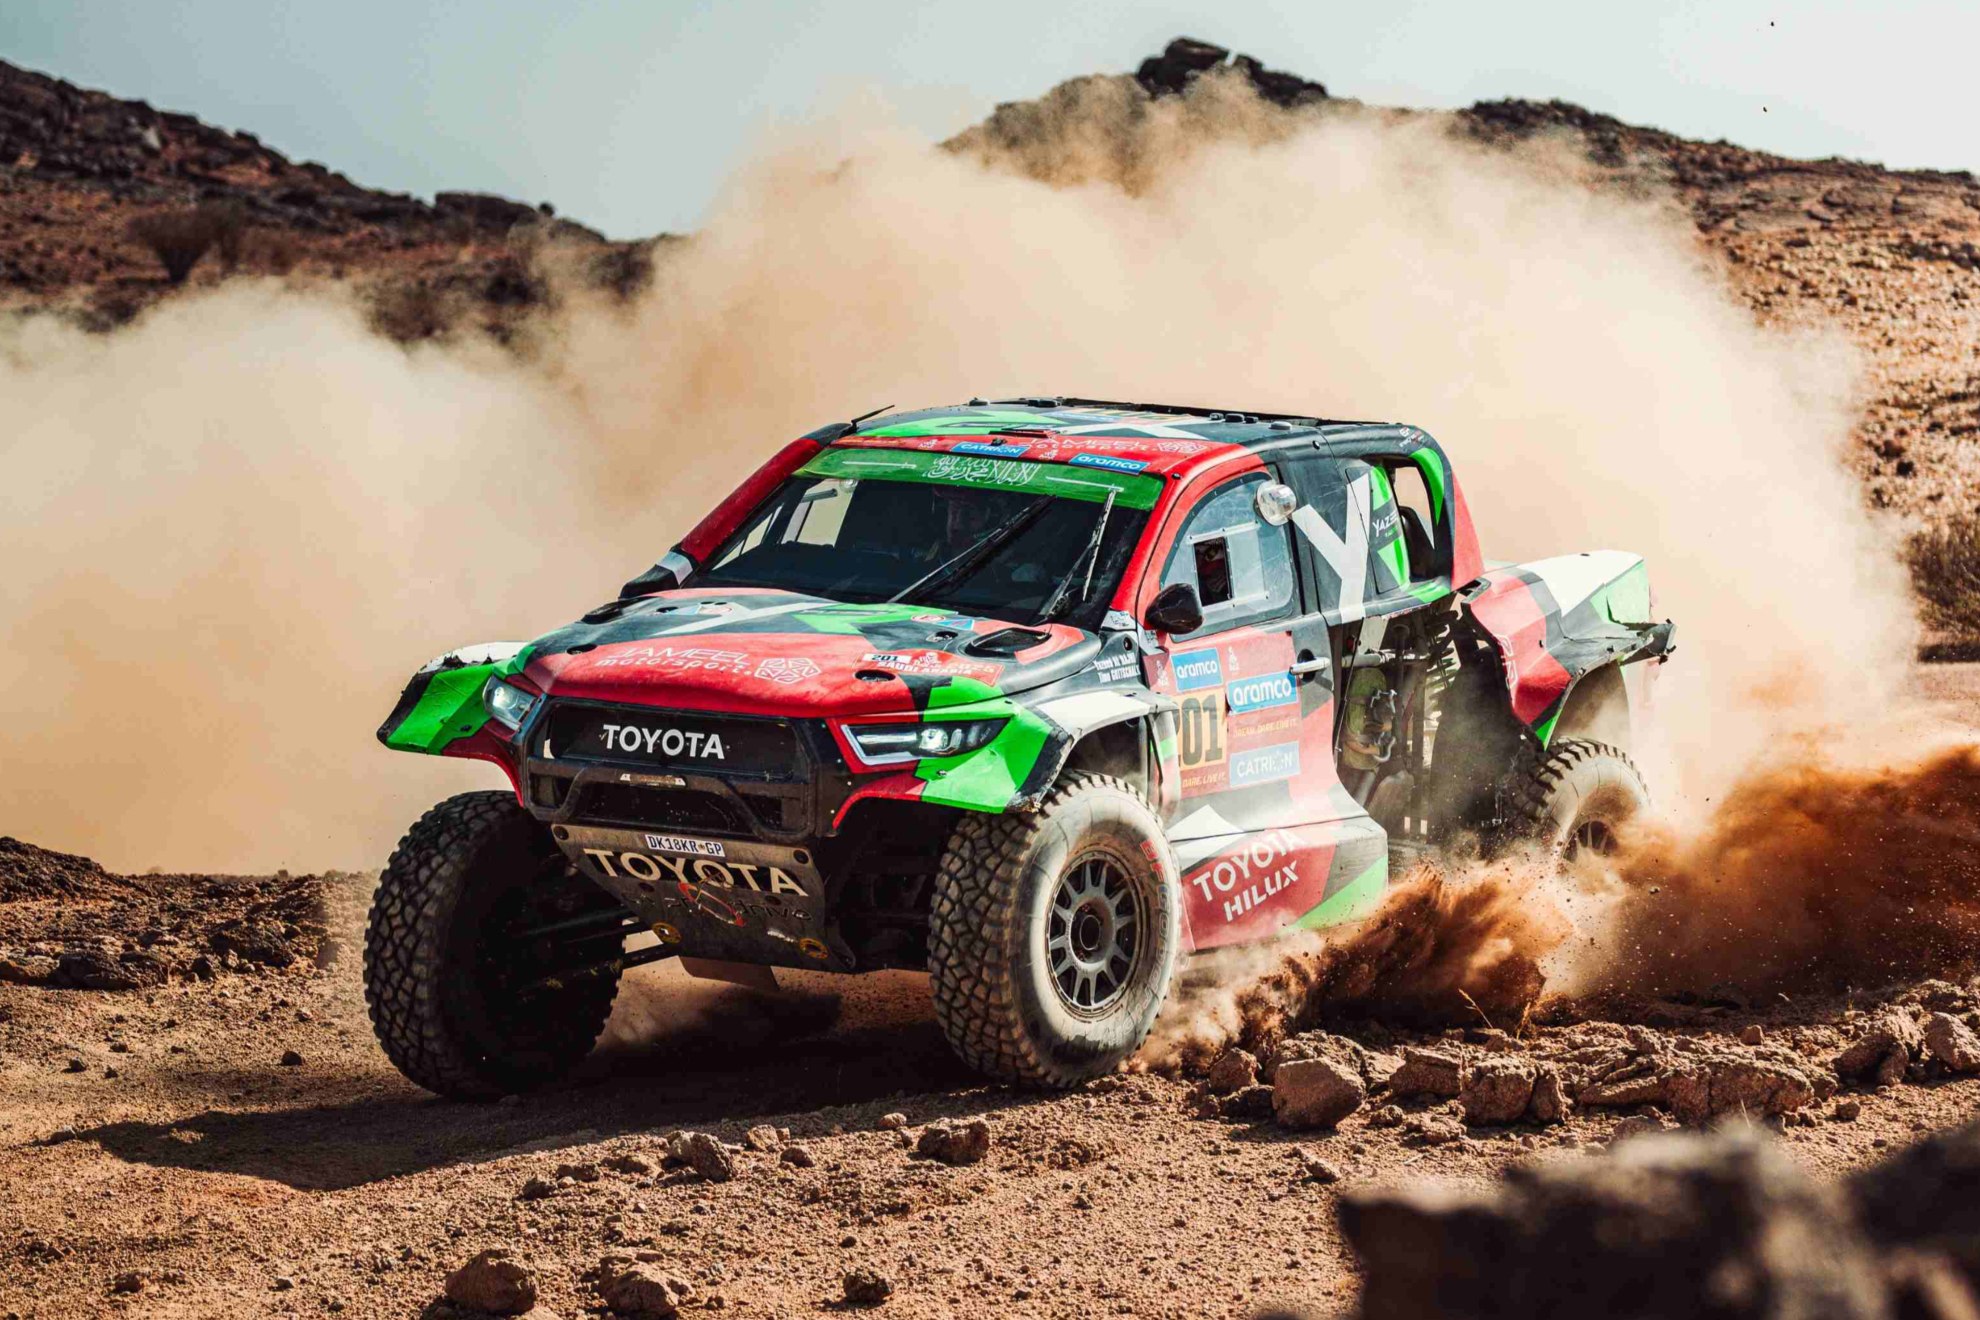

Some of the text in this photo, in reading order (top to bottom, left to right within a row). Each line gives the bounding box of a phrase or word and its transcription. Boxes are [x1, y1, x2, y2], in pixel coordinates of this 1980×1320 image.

[1077, 456, 1140, 470] aramco
[607, 648, 750, 665] JAMEEL
[877, 661, 918, 672] SAUDI
[1177, 660, 1218, 679] aramco
[1233, 679, 1292, 706] aramco
[603, 723, 725, 760] TOYOTA
[1173, 694, 1223, 766] 01
[648, 836, 721, 855] DK18KR GP
[583, 848, 809, 897] TOYOTA
[1223, 859, 1299, 922] HILUX
